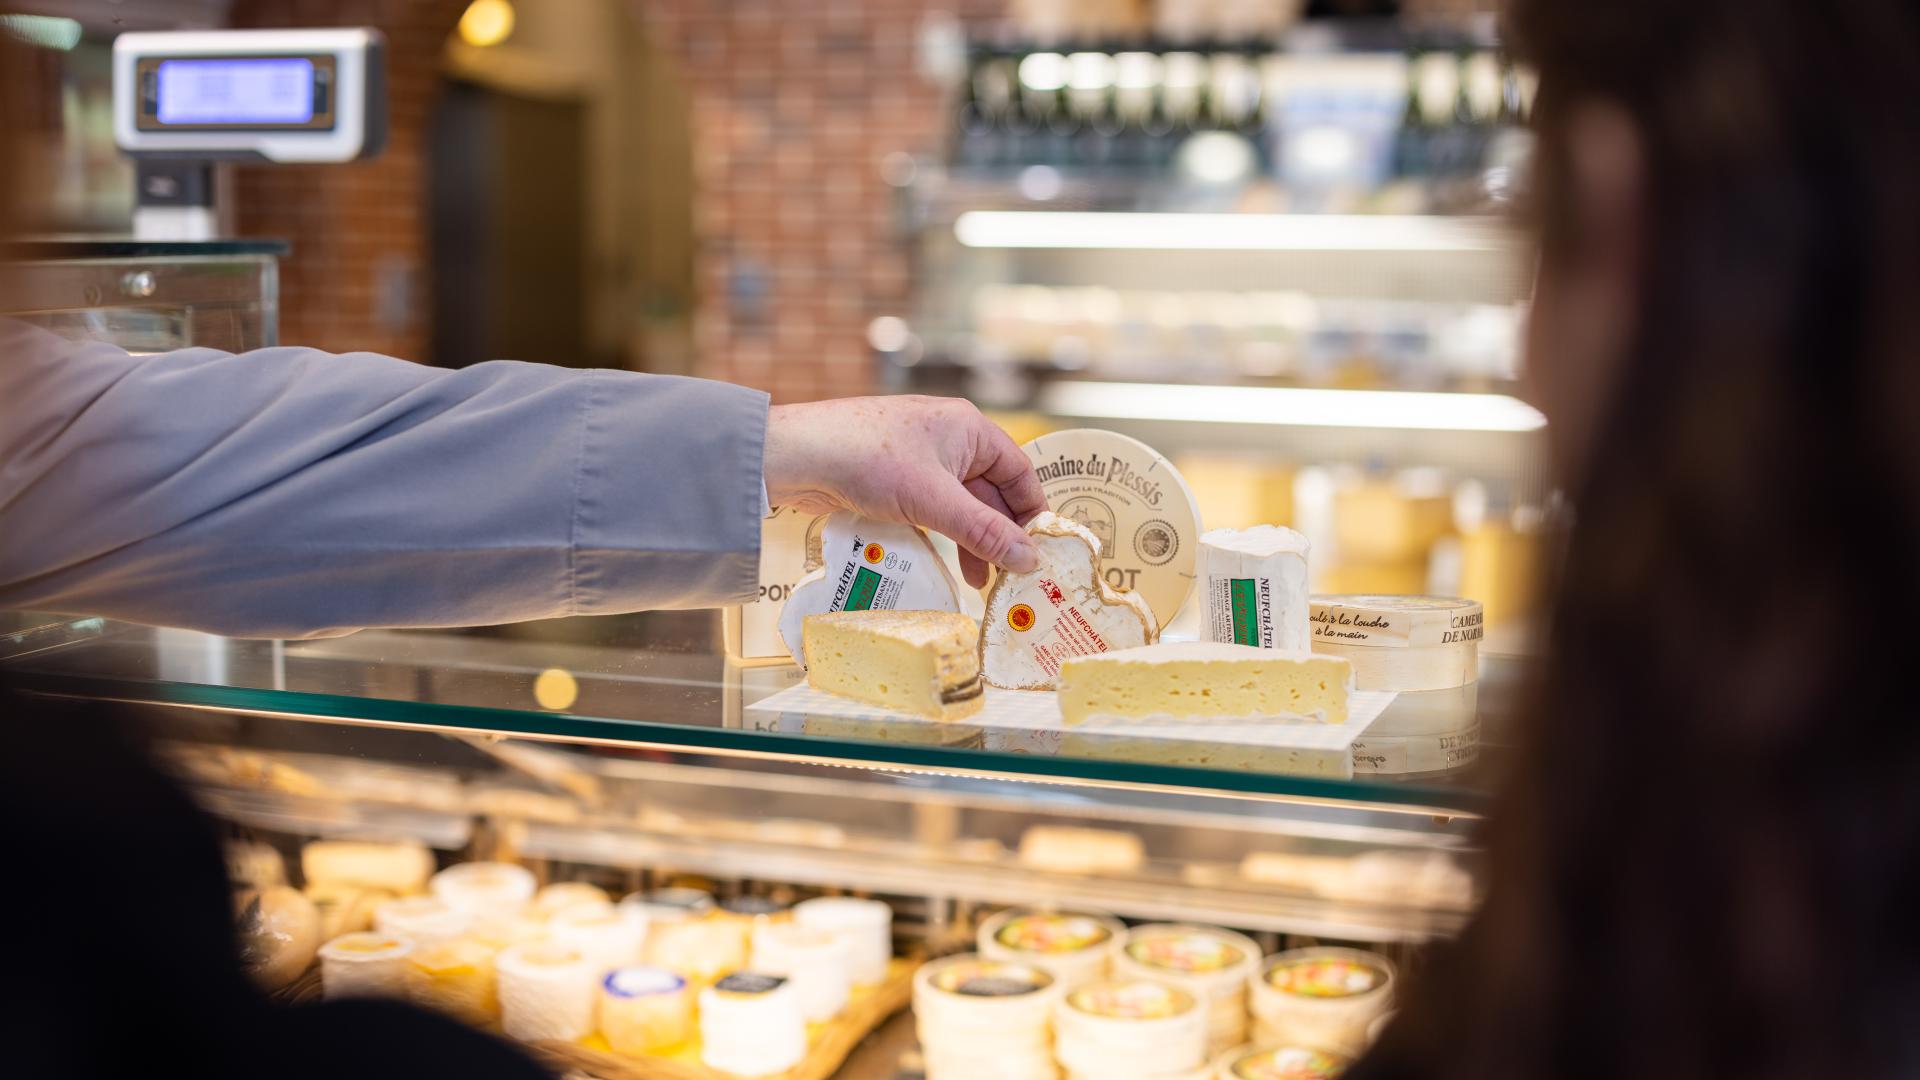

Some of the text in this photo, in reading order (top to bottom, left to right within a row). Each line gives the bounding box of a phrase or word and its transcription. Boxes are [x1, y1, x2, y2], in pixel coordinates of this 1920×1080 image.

[1037, 454, 1163, 506] maine du Plessis
[1053, 489, 1069, 497] CRU
[1093, 486, 1131, 506] TRADITION
[828, 560, 856, 613] UFCHÂTEL
[1105, 567, 1142, 590] OT
[759, 583, 795, 602] PON
[873, 576, 890, 610] ARTISANAL
[1068, 606, 1108, 653] NEUFCHÂTEL
[1225, 613, 1233, 644] ARTISAN
[1309, 611, 1328, 623] oulé
[1338, 613, 1352, 625] la
[1353, 614, 1390, 629] louche
[1315, 625, 1369, 640] à la main
[1441, 630, 1460, 644] DE
